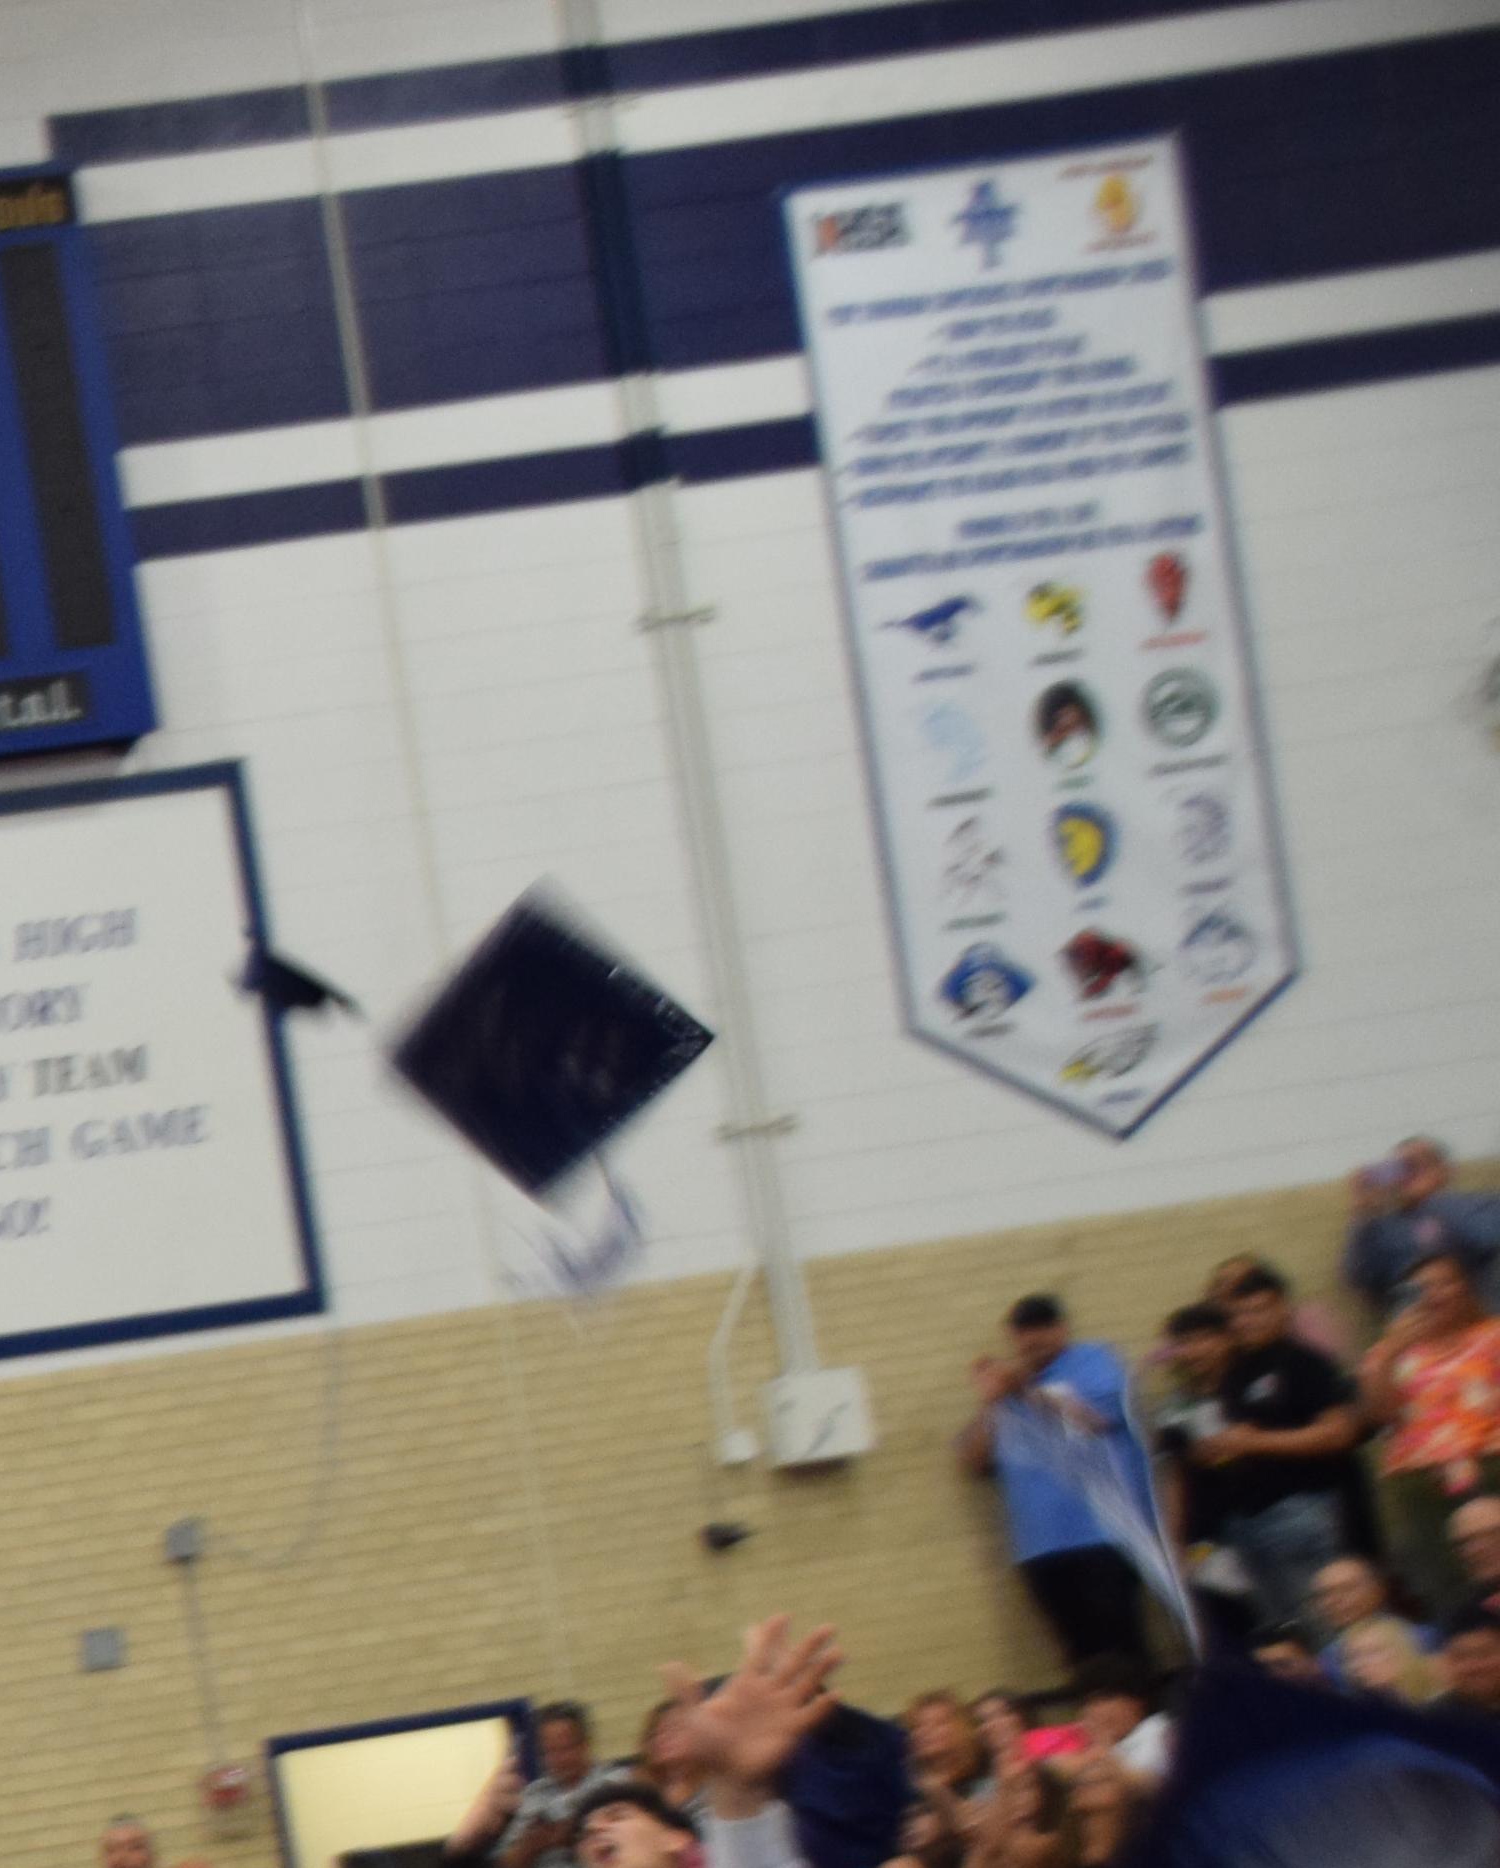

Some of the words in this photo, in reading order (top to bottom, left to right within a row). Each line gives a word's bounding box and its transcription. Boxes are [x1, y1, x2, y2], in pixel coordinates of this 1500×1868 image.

[13, 907, 137, 963] HIGH
[29, 1043, 150, 1098] TEAM
[70, 1104, 210, 1160] GAME
